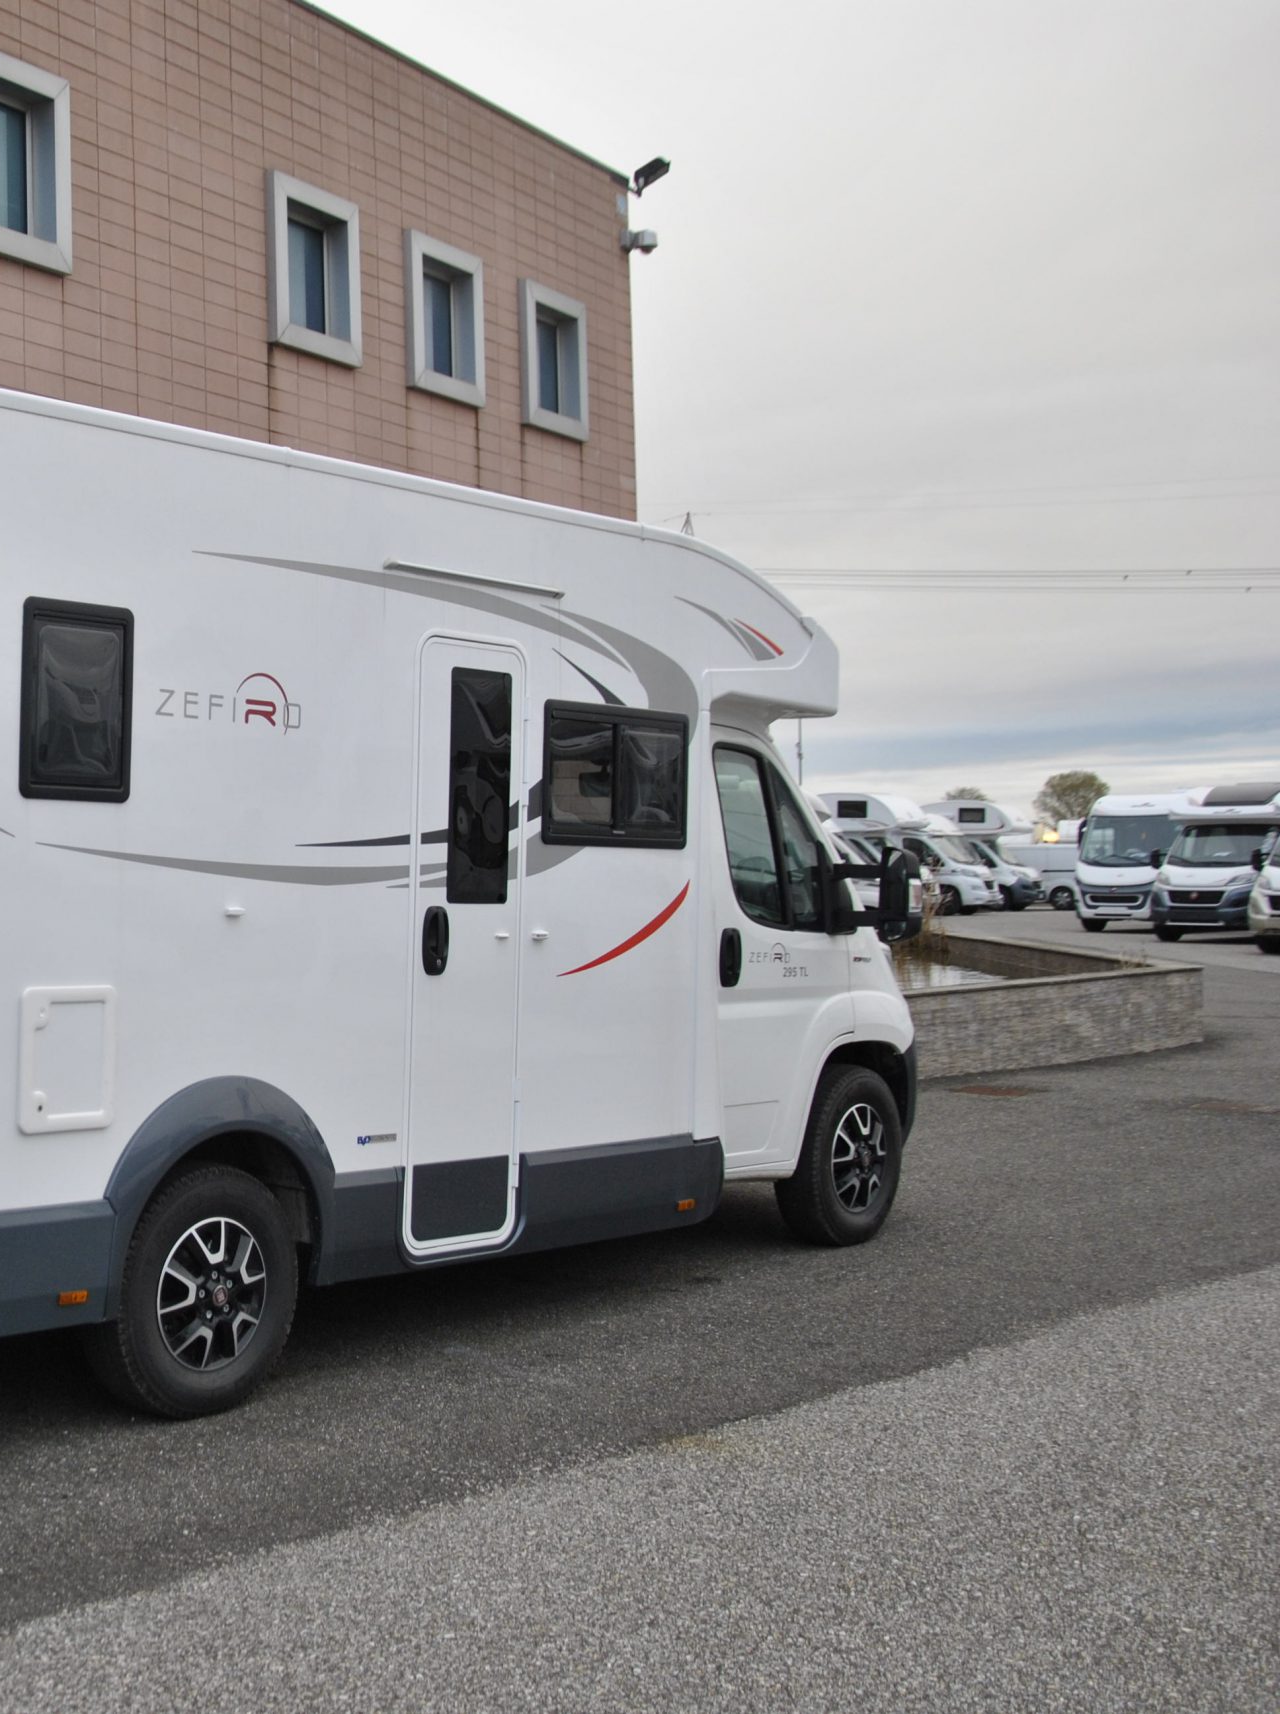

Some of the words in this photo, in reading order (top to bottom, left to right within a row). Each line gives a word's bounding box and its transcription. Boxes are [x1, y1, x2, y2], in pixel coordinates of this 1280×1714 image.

[155, 675, 301, 733] ZEFIRO
[783, 967, 798, 977] 295
[799, 967, 809, 977] TL
